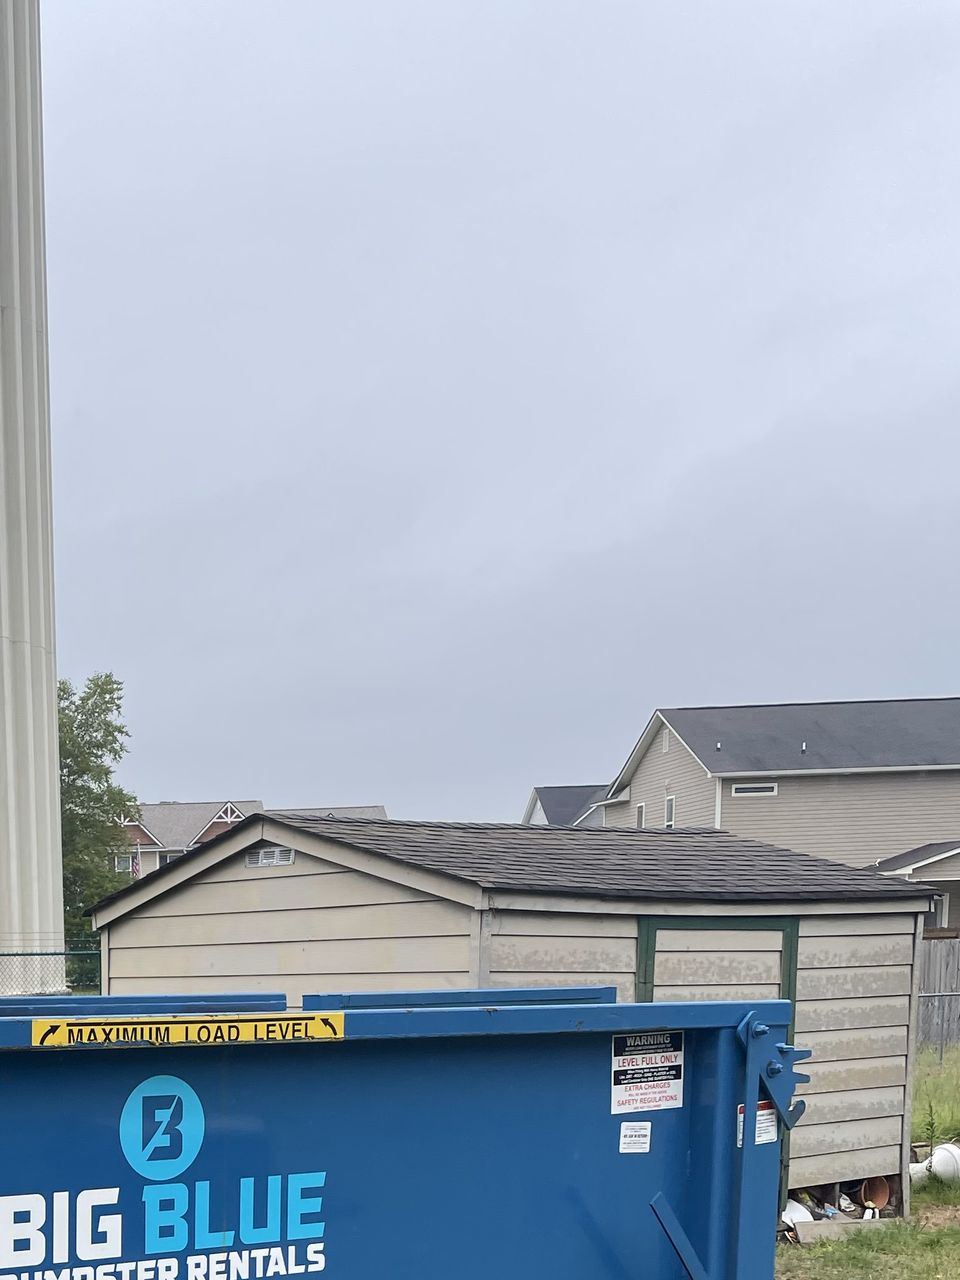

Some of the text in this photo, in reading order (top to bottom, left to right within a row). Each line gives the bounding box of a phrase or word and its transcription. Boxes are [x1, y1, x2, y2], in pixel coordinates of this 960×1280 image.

[67, 1022, 314, 1045] MAXIMUM LOAD LEVEL
[626, 1034, 671, 1046] WARNING
[618, 1054, 678, 1068] LEVEL FULL ONLY
[624, 1082, 671, 1092] EXTRA CHARGES
[617, 1098, 639, 1107] SAFETY
[639, 1094, 678, 1105] REGULATIONS
[142, 1171, 326, 1255] BLUE
